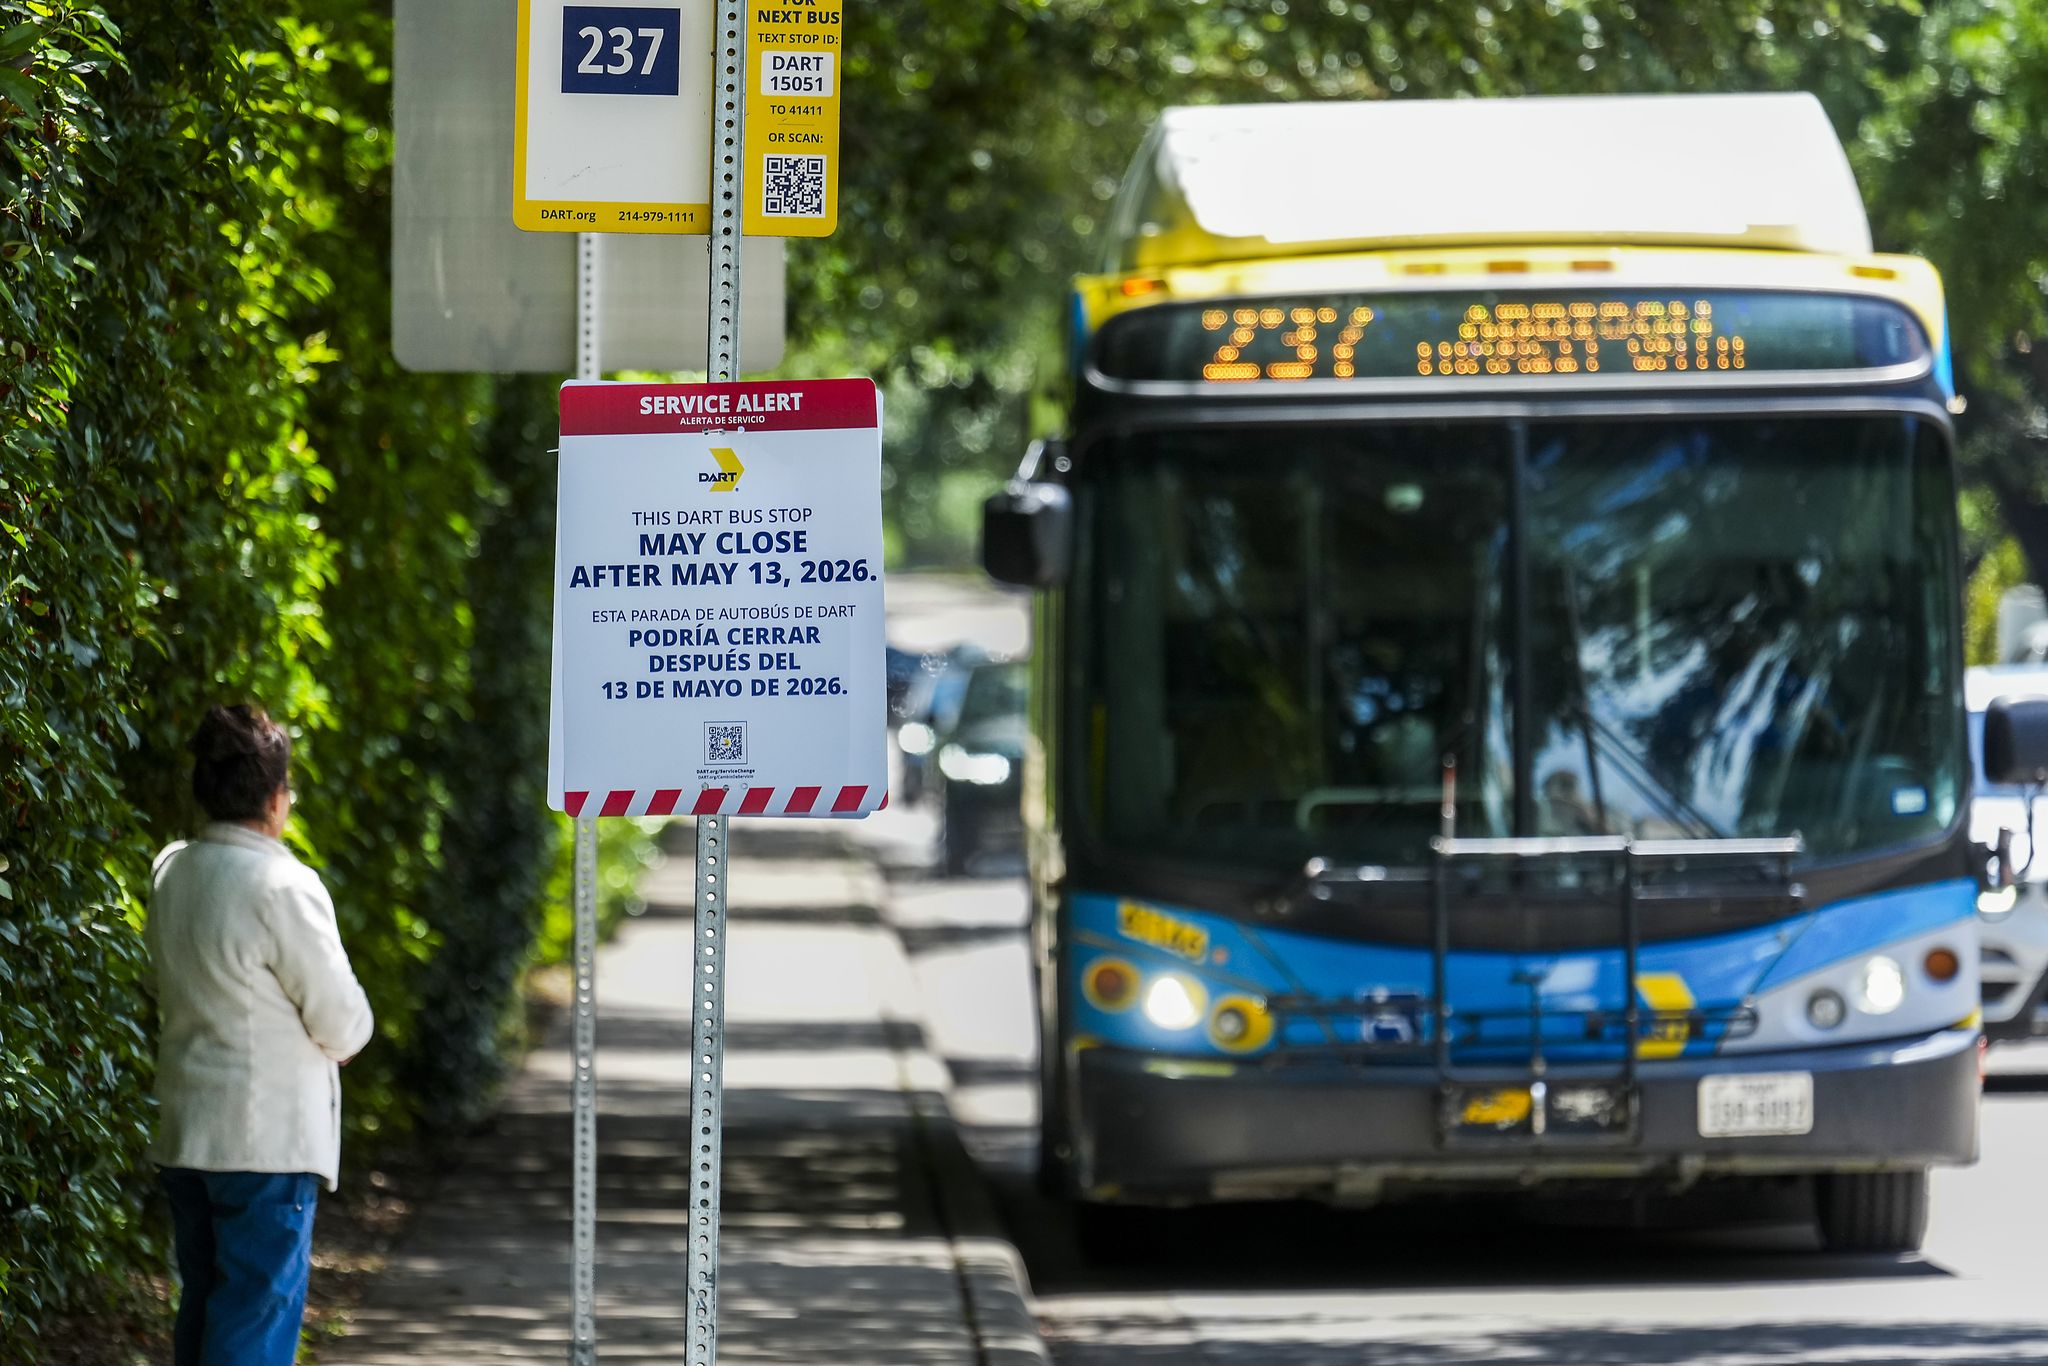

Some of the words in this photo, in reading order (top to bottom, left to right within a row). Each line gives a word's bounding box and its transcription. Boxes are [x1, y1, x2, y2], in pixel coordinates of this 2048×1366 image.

[758, 10, 802, 23] NEXT
[808, 11, 839, 24] BUS
[758, 33, 786, 43] TEXT
[789, 34, 819, 43] STOP
[823, 35, 838, 44] ID:
[578, 27, 664, 74] 237
[773, 56, 823, 71] DART
[771, 76, 822, 91] 15051
[770, 105, 785, 114] TO
[789, 106, 821, 115] 41411
[769, 133, 785, 142] OR
[789, 133, 823, 143] SCAN:
[542, 210, 596, 223] DART.org
[619, 211, 695, 223] 214-979-1111
[1202, 306, 1374, 382] 237
[640, 395, 729, 414] SERVICE
[736, 393, 803, 412] ALERT
[728, 416, 765, 424] SERVICIO
[699, 472, 737, 482] DART
[632, 511, 670, 526] THIS
[678, 510, 723, 525] DART
[730, 510, 762, 523] BUS
[769, 508, 812, 523] STOP
[640, 533, 706, 556] MAY
[716, 530, 807, 554] CLOSE
[570, 565, 662, 588] AFTER
[672, 563, 738, 585] MAY
[749, 562, 790, 587] 13,
[801, 559, 876, 583] 2026.
[593, 610, 626, 622] ESTA
[632, 609, 690, 621] PARADA
[696, 609, 714, 620] DE
[719, 604, 789, 620] AUTOBÚS
[795, 606, 812, 618] DE
[818, 605, 856, 618] DART
[630, 624, 720, 647] PODRÍA
[727, 626, 821, 645] CERRAR
[650, 648, 750, 672] DESPUÉS
[759, 653, 801, 670] DEL
[602, 682, 628, 699] 13
[637, 681, 664, 698] DE
[673, 679, 742, 698] MAYO
[751, 678, 779, 696] DE
[787, 677, 847, 696] 2026.
